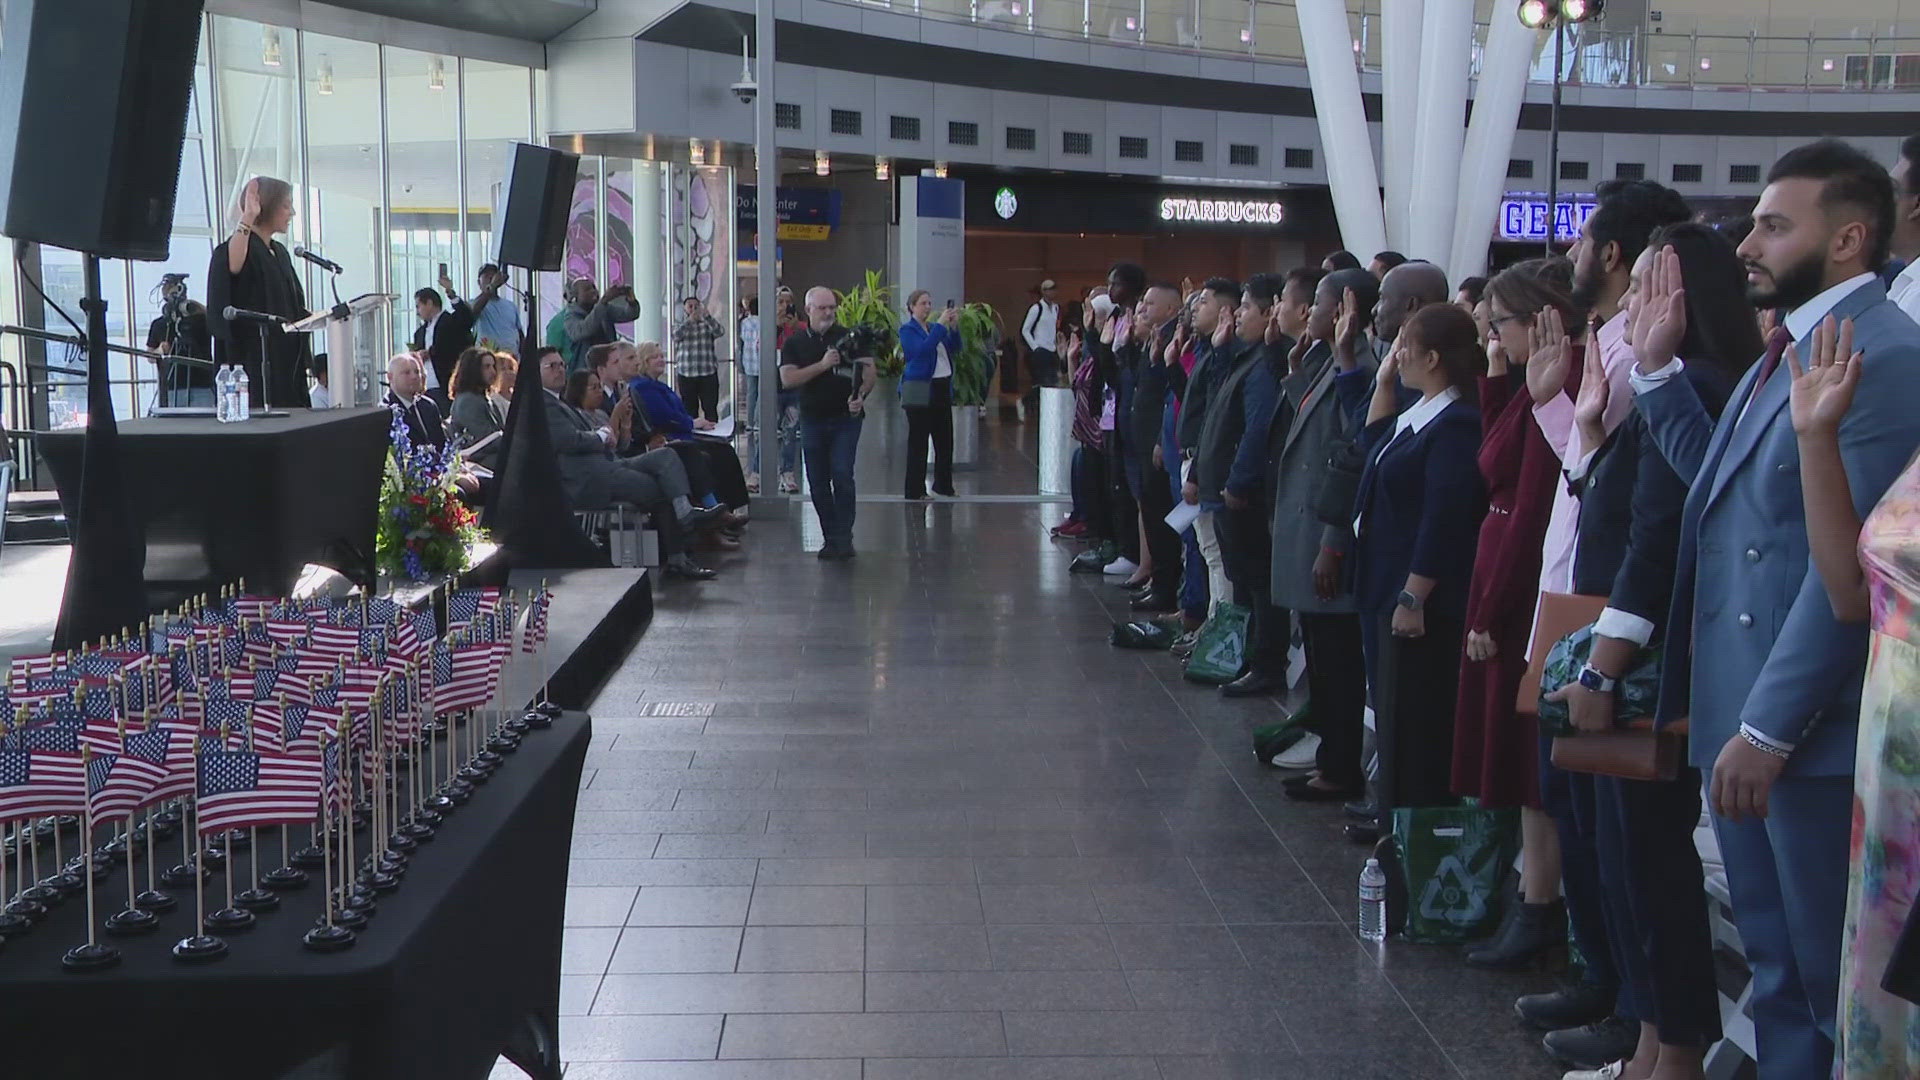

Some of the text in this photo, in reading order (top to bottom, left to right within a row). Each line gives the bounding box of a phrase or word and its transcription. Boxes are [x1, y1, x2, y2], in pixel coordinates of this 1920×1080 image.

[735, 196, 750, 208] Do
[776, 199, 799, 210] nter
[1160, 198, 1282, 223] STARBUCKS
